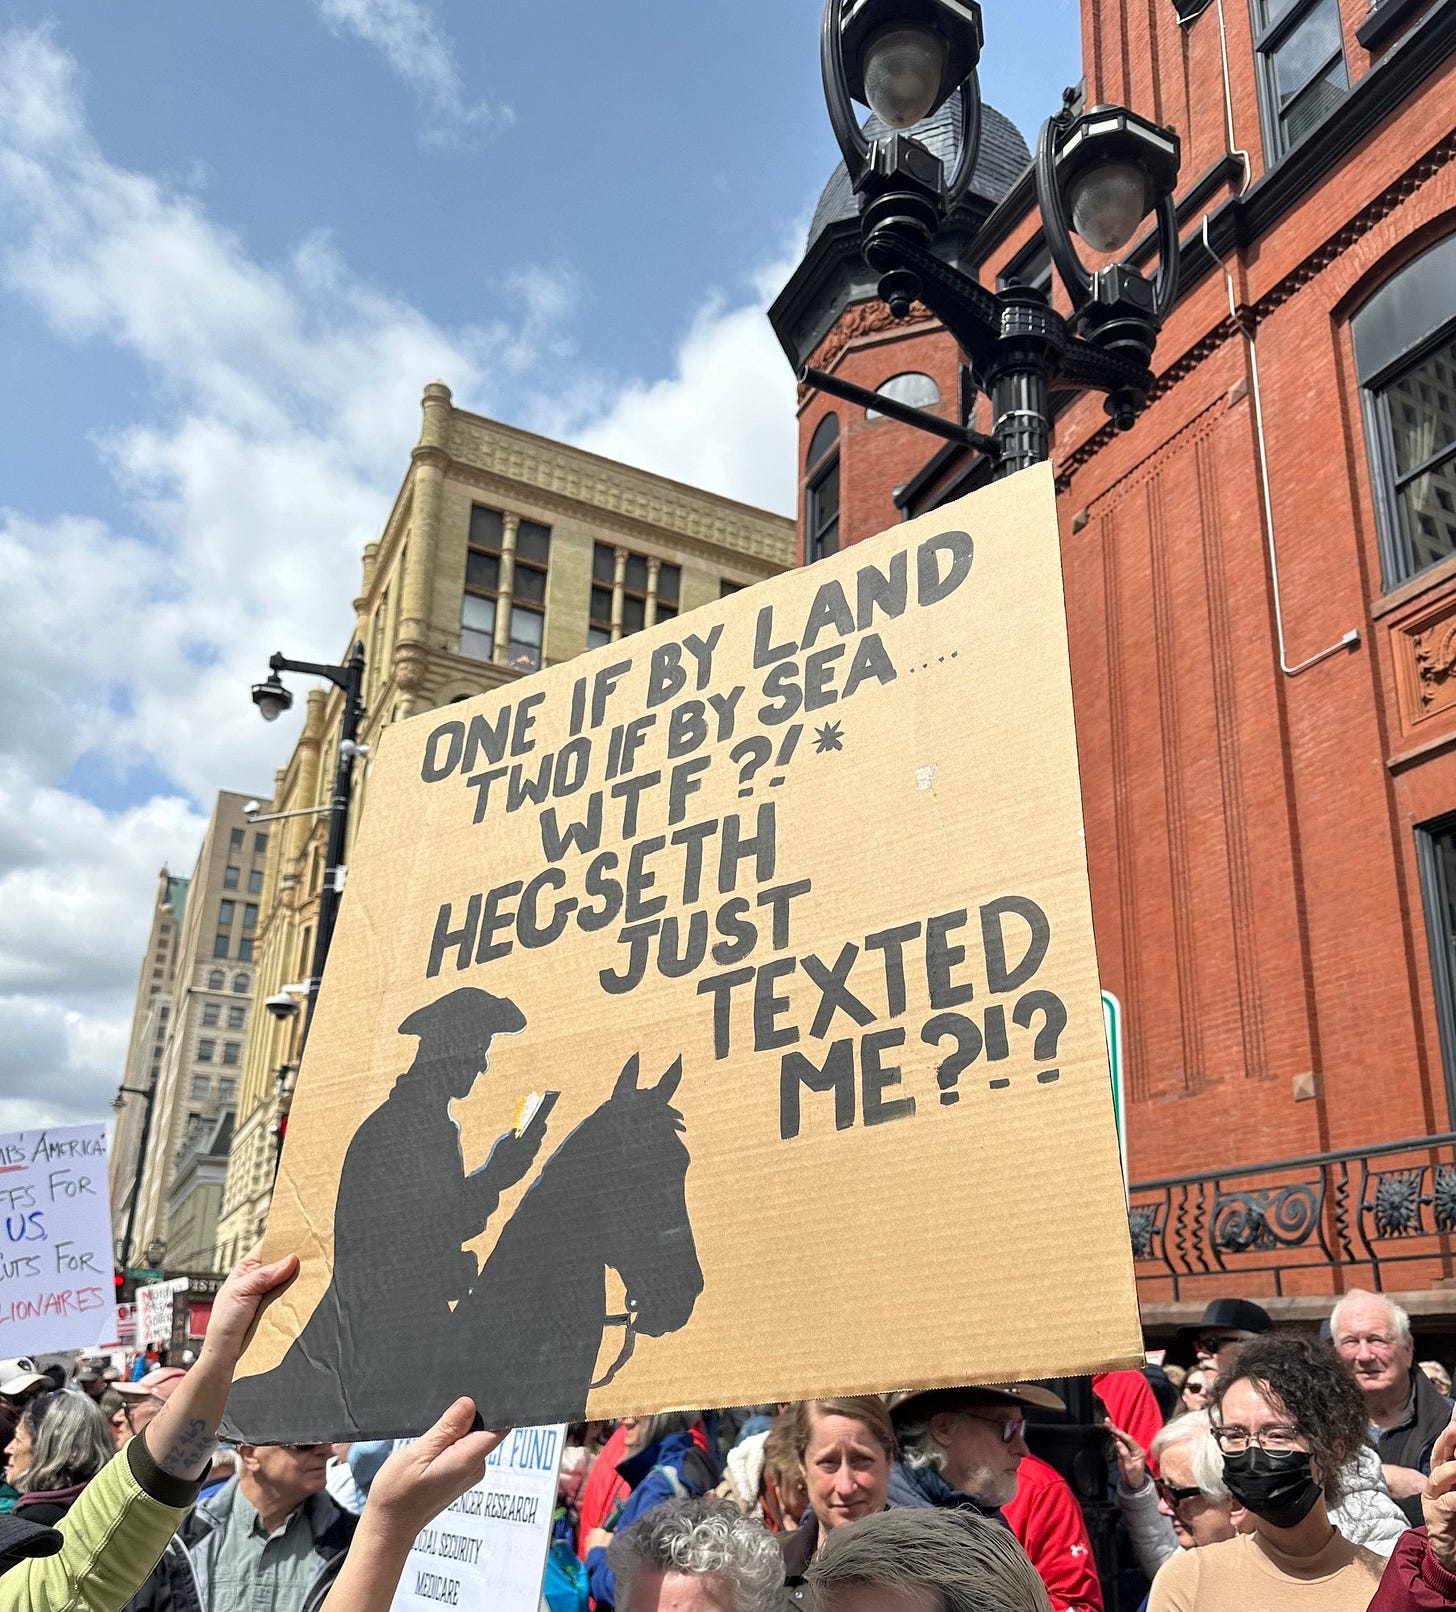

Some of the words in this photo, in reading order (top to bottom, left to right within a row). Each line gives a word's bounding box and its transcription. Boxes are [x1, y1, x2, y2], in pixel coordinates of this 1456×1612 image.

[421, 692, 545, 783] ONE
[570, 659, 632, 736] IF
[647, 624, 725, 708] BY
[753, 531, 974, 668] LAND
[466, 737, 590, 824] TWO
[605, 713, 655, 781] IF
[667, 686, 745, 760] BY
[426, 801, 776, 978] HEGSETH
[600, 879, 811, 995] JUST
[696, 896, 1050, 1059] TEXTED
[49, 1169, 96, 1203] FOR
[55, 1240, 105, 1275] FOR
[509, 1428, 557, 1471] FUND
[485, 1493, 539, 1524] RESEARCH
[413, 1529, 439, 1556] OCIAL
[438, 1533, 483, 1565] SECURITY
[414, 1570, 461, 1606] MEDICARE
